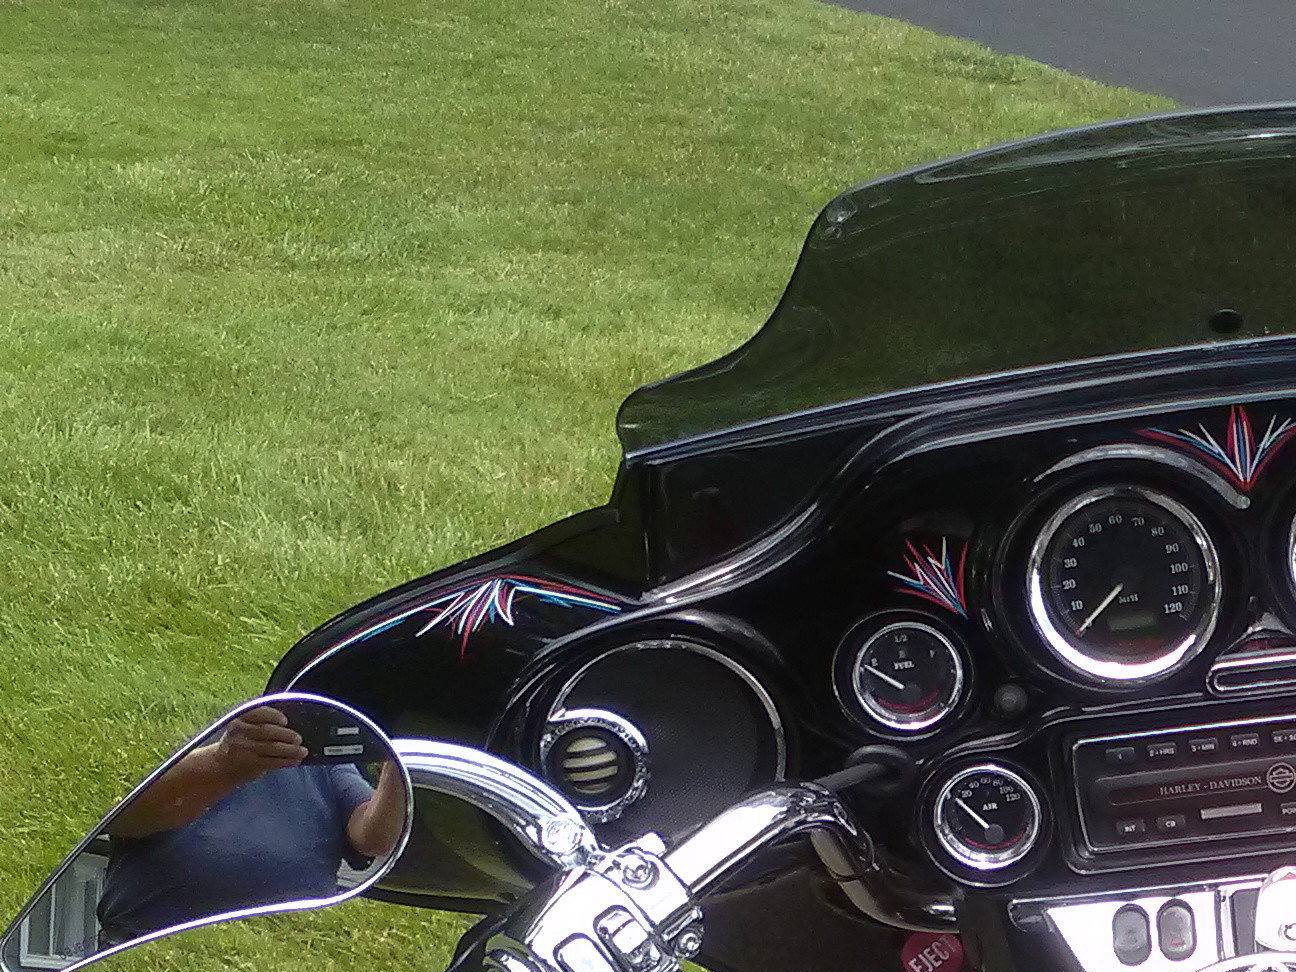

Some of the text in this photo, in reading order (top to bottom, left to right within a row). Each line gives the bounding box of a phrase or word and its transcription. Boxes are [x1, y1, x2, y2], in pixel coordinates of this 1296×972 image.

[1108, 514, 1123, 525] 60
[1132, 516, 1145, 527] 70
[1151, 526, 1164, 537] 80
[1072, 537, 1085, 548] 40
[1165, 543, 1179, 553] 90
[1064, 558, 1077, 569] 30
[1170, 563, 1188, 574] 100
[1063, 579, 1076, 590] 20
[1172, 585, 1189, 596] 110
[1071, 600, 1083, 611] 10
[1164, 602, 1183, 614] 120
[894, 660, 915, 670] FUEL
[982, 802, 998, 811] AIR
